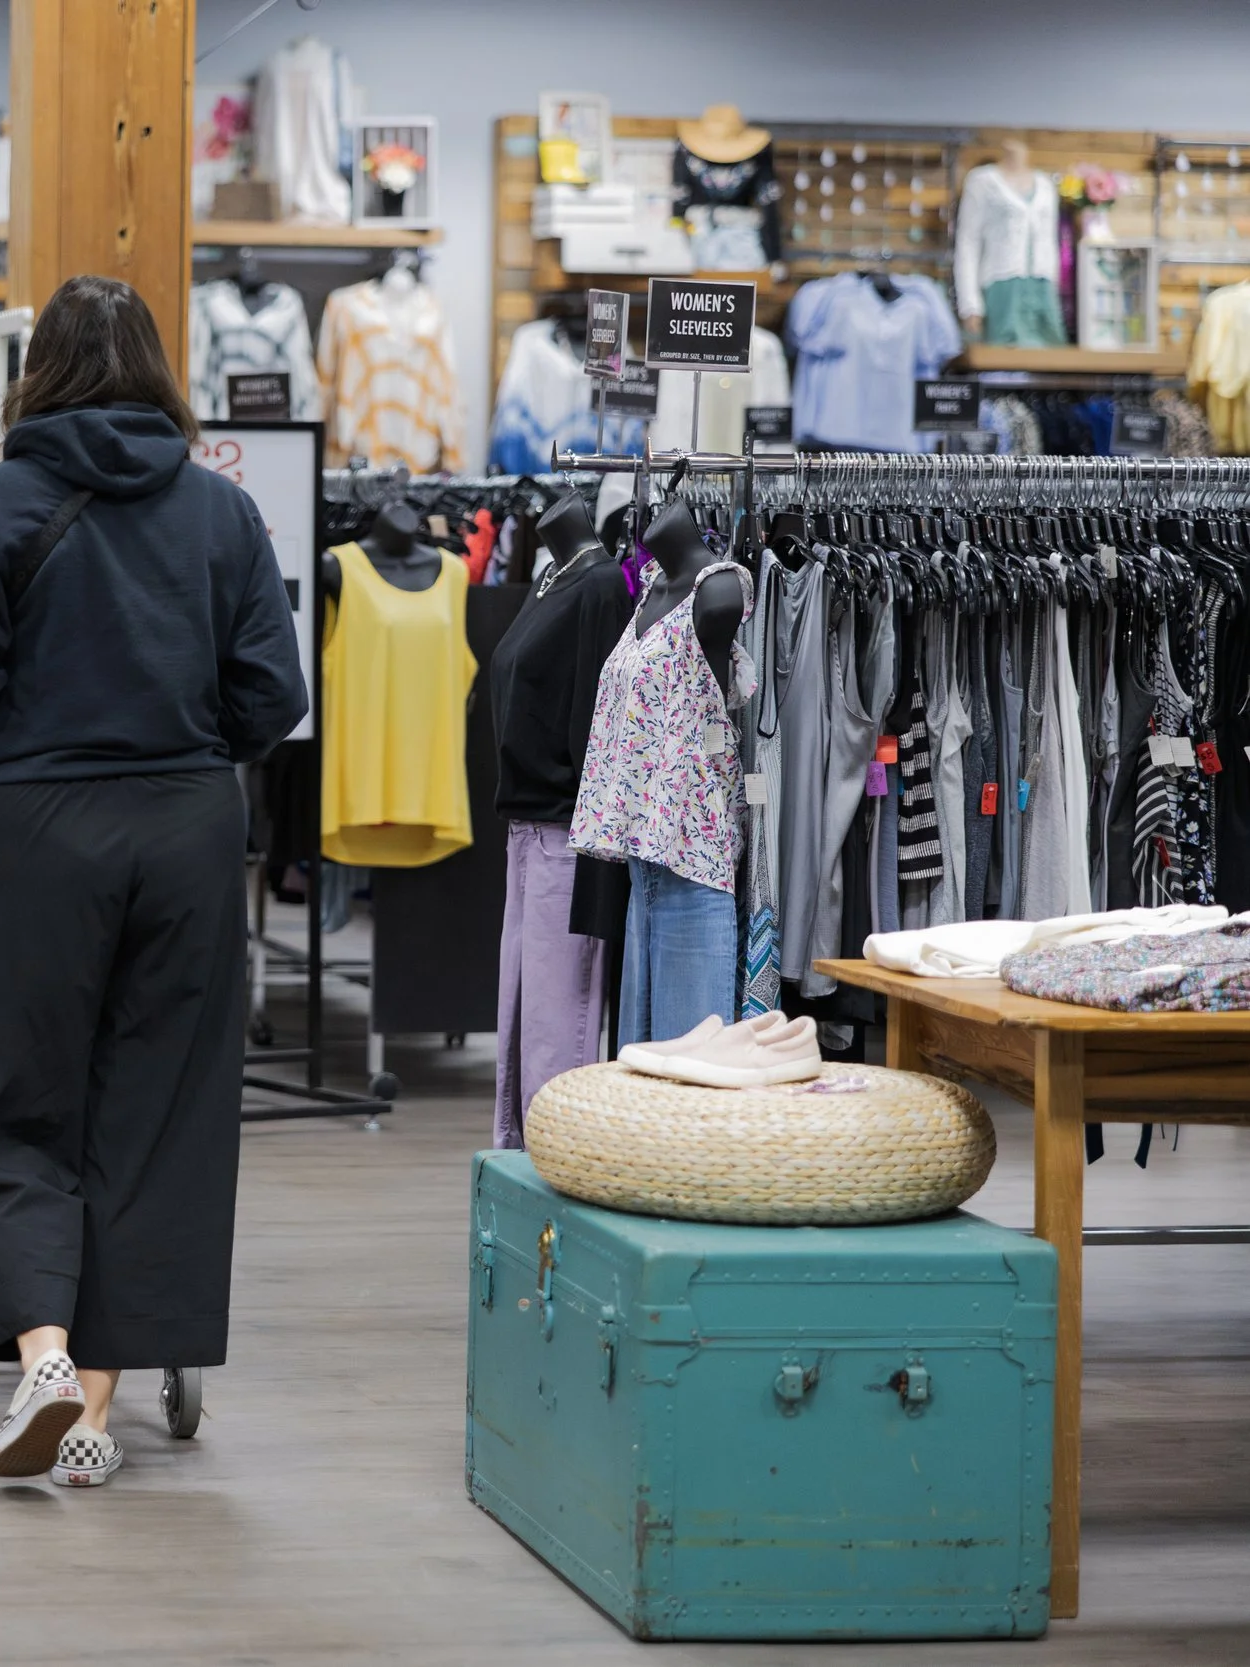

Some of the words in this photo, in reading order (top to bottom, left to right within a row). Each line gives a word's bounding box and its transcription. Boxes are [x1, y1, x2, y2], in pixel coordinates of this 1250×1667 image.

[671, 292, 735, 313] WOMEN'S
[593, 303, 617, 321] WOMEN'S
[592, 328, 616, 343] SLEEVELESS
[669, 319, 733, 338] SLEEVELESS
[659, 351, 681, 359] GROUPED
[690, 353, 702, 361] SIZE,
